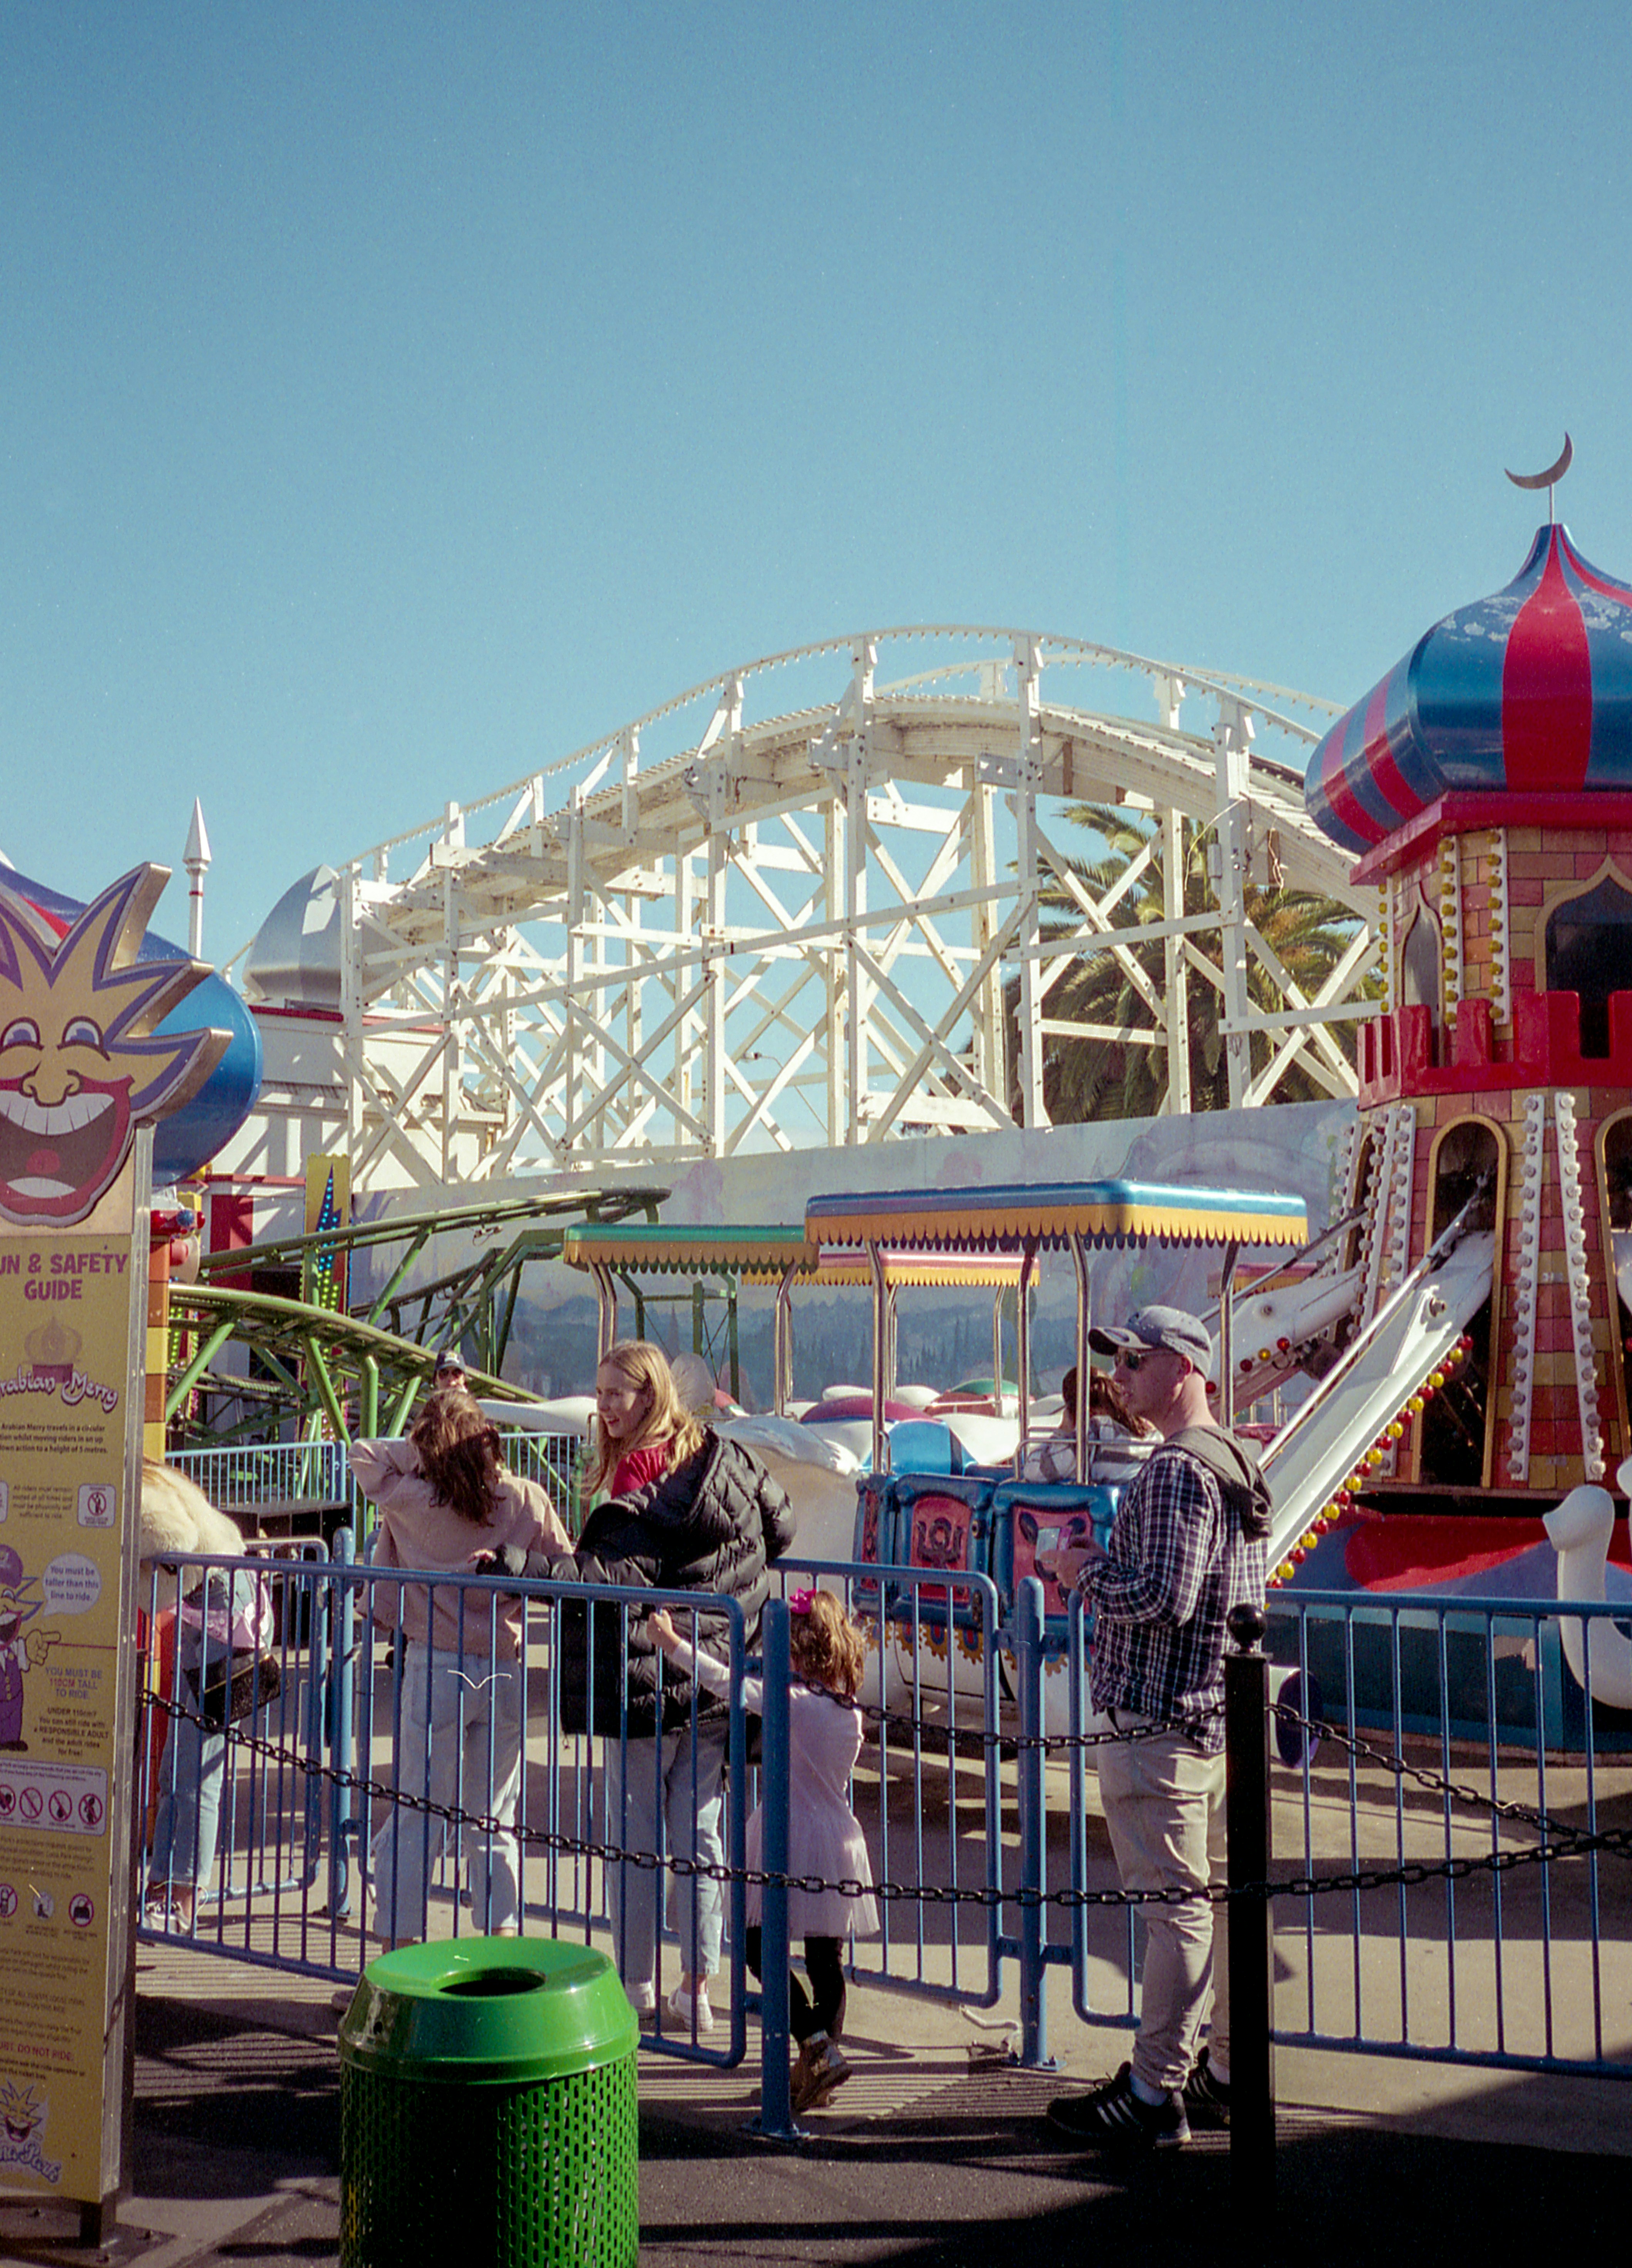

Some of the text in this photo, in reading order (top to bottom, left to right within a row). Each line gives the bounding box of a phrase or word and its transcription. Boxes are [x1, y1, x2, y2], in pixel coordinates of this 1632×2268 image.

[0, 1253, 128, 1275] UN & SAFETY
[24, 1279, 82, 1301] GUIDE
[0, 1365, 118, 1414] rabian Merry
[27, 1424, 45, 1432] Merry
[33, 1435, 57, 1444] moving
[50, 1445, 70, 1454] height
[50, 1565, 95, 1576] You must be
[45, 1578, 99, 1588] taller than this
[50, 1590, 92, 1601] line to ride.
[45, 1667, 102, 1679] YOU MUST BE
[50, 1678, 97, 1689] 110CM TALL
[56, 1688, 67, 1697] TO
[47, 1707, 70, 1715] UNDER
[39, 1726, 85, 1737] RESPONSIBLE
[87, 1729, 109, 1739] ADULT
[18, 2043, 30, 2054] DO
[32, 2046, 50, 2058] NOT
